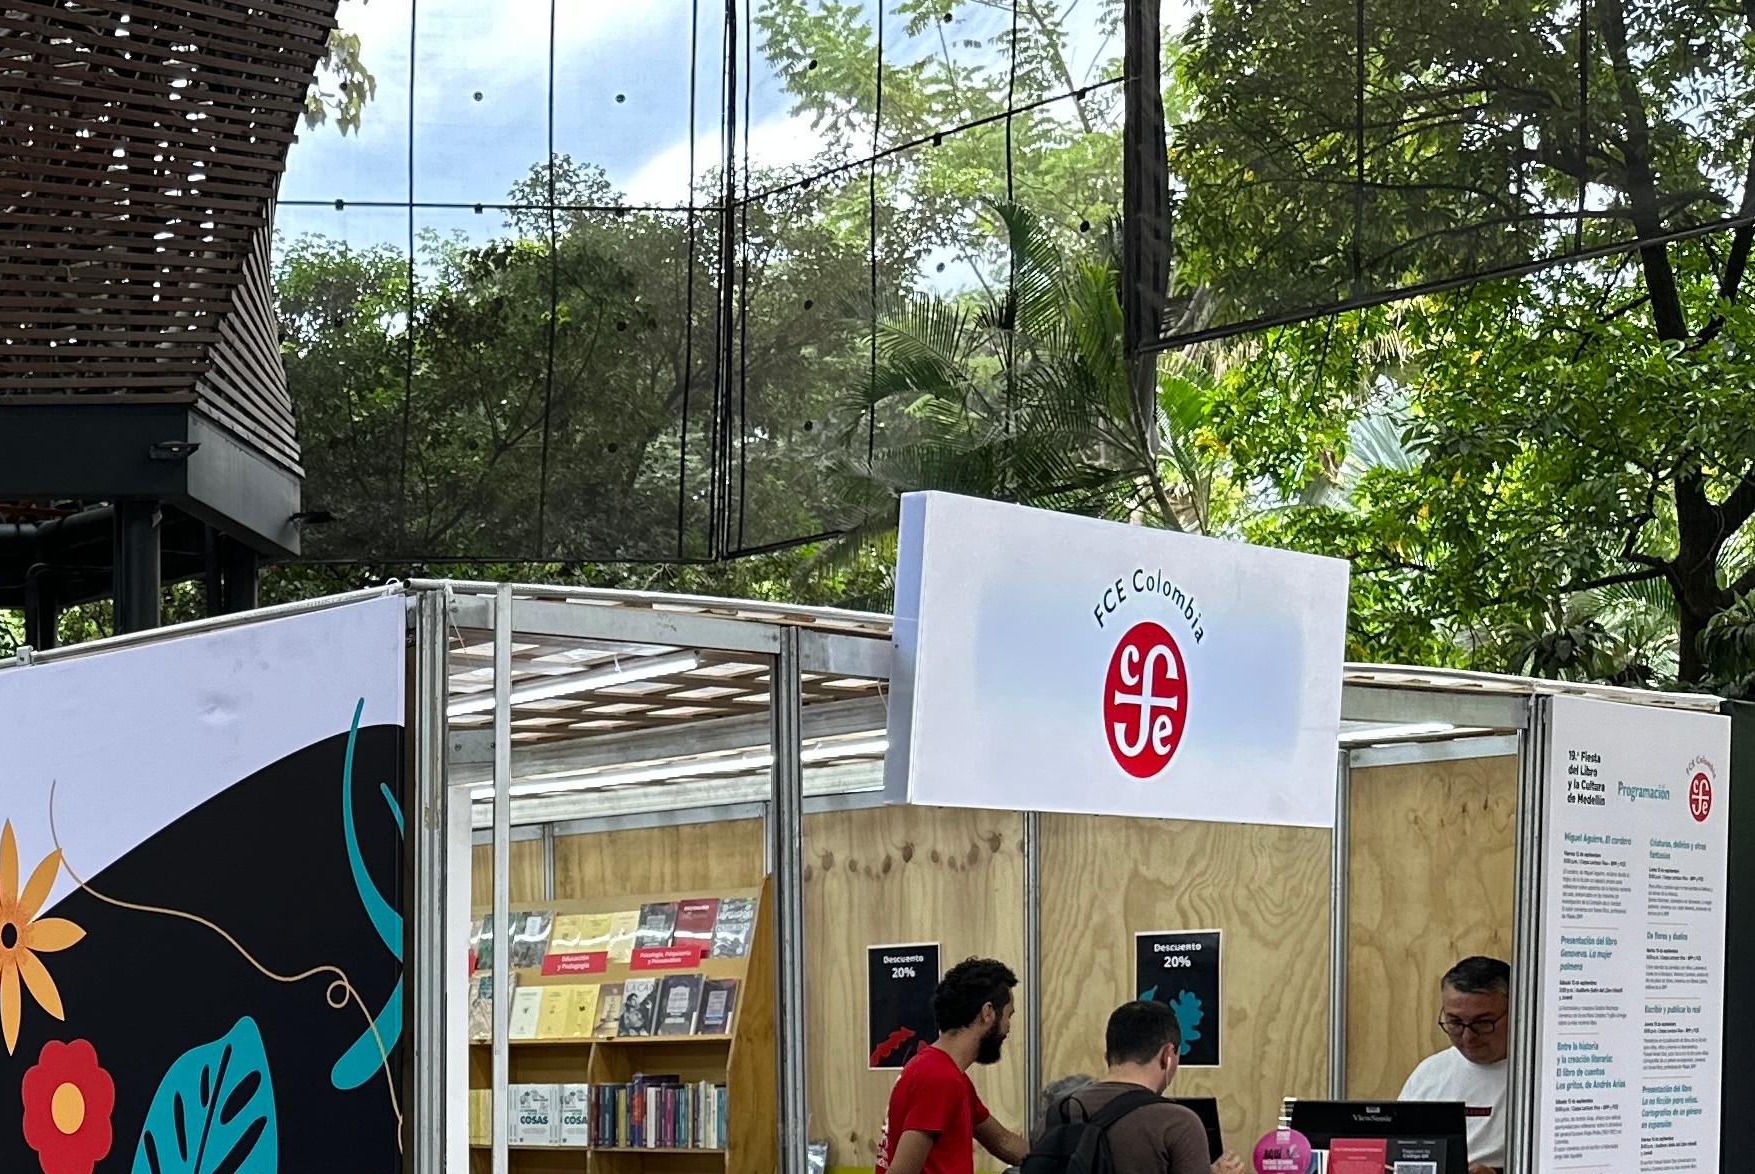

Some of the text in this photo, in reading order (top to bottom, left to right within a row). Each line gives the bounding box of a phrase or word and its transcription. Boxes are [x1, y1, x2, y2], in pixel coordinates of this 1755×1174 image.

[1094, 568, 1204, 644] FCE Colombia
[1580, 765, 1598, 778] Libro
[1581, 780, 1605, 791] Cultura
[1618, 781, 1670, 802] Programación
[1153, 942, 1202, 953] Descuento
[882, 954, 925, 964] Descuento
[1163, 956, 1192, 968] 20%
[891, 966, 916, 979] 20%
[520, 1115, 549, 1125] COSAS
[564, 1115, 588, 1125] COSA
[1352, 1114, 1393, 1122] ViewSonic
